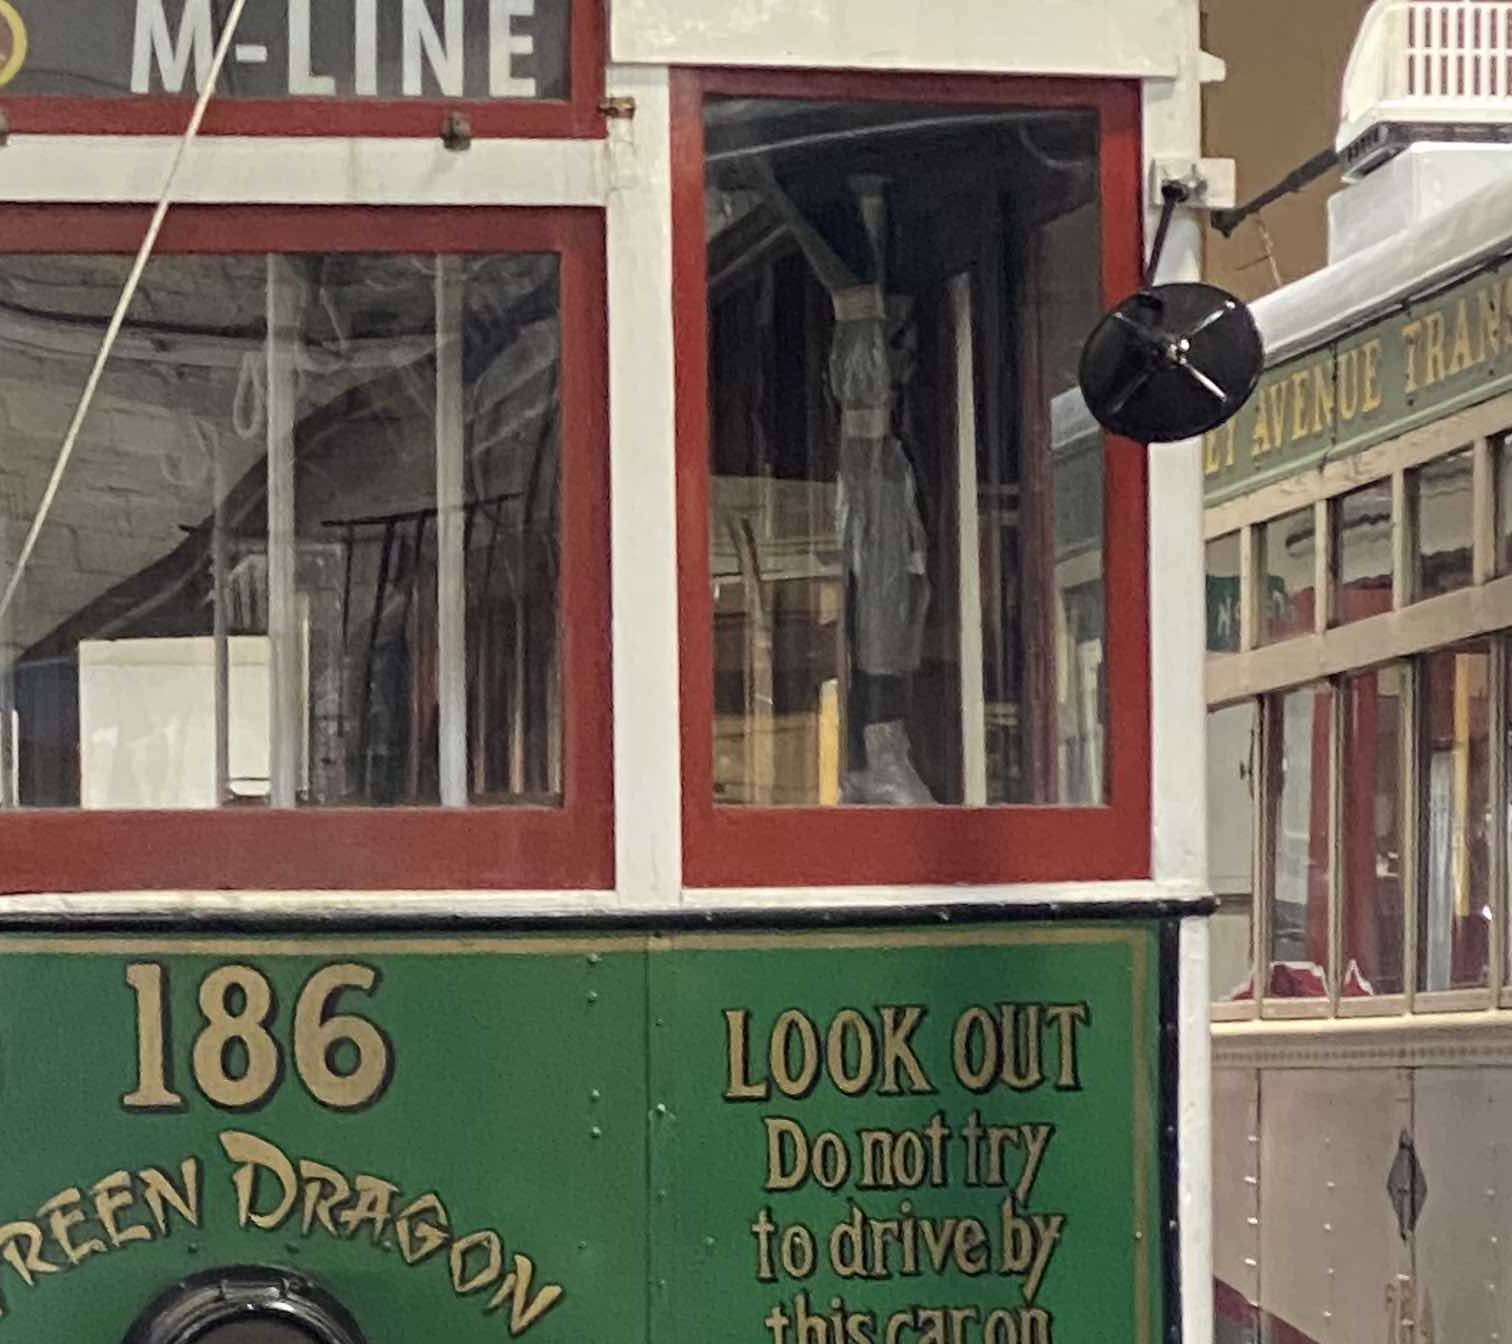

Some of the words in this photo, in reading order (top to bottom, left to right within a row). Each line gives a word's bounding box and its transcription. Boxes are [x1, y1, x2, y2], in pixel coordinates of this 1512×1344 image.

[1252, 339, 1383, 456] AVENUE
[122, 962, 391, 1110] 186
[724, 1006, 936, 1100] LOOK
[952, 1002, 1089, 1093] OUT
[764, 1116, 849, 1191] Do
[857, 1112, 950, 1188] not
[961, 1110, 1054, 1206] try
[220, 1129, 563, 1337] DRAGON
[751, 1207, 815, 1281] to
[830, 1199, 987, 1280] drive
[999, 1194, 1065, 1302] by
